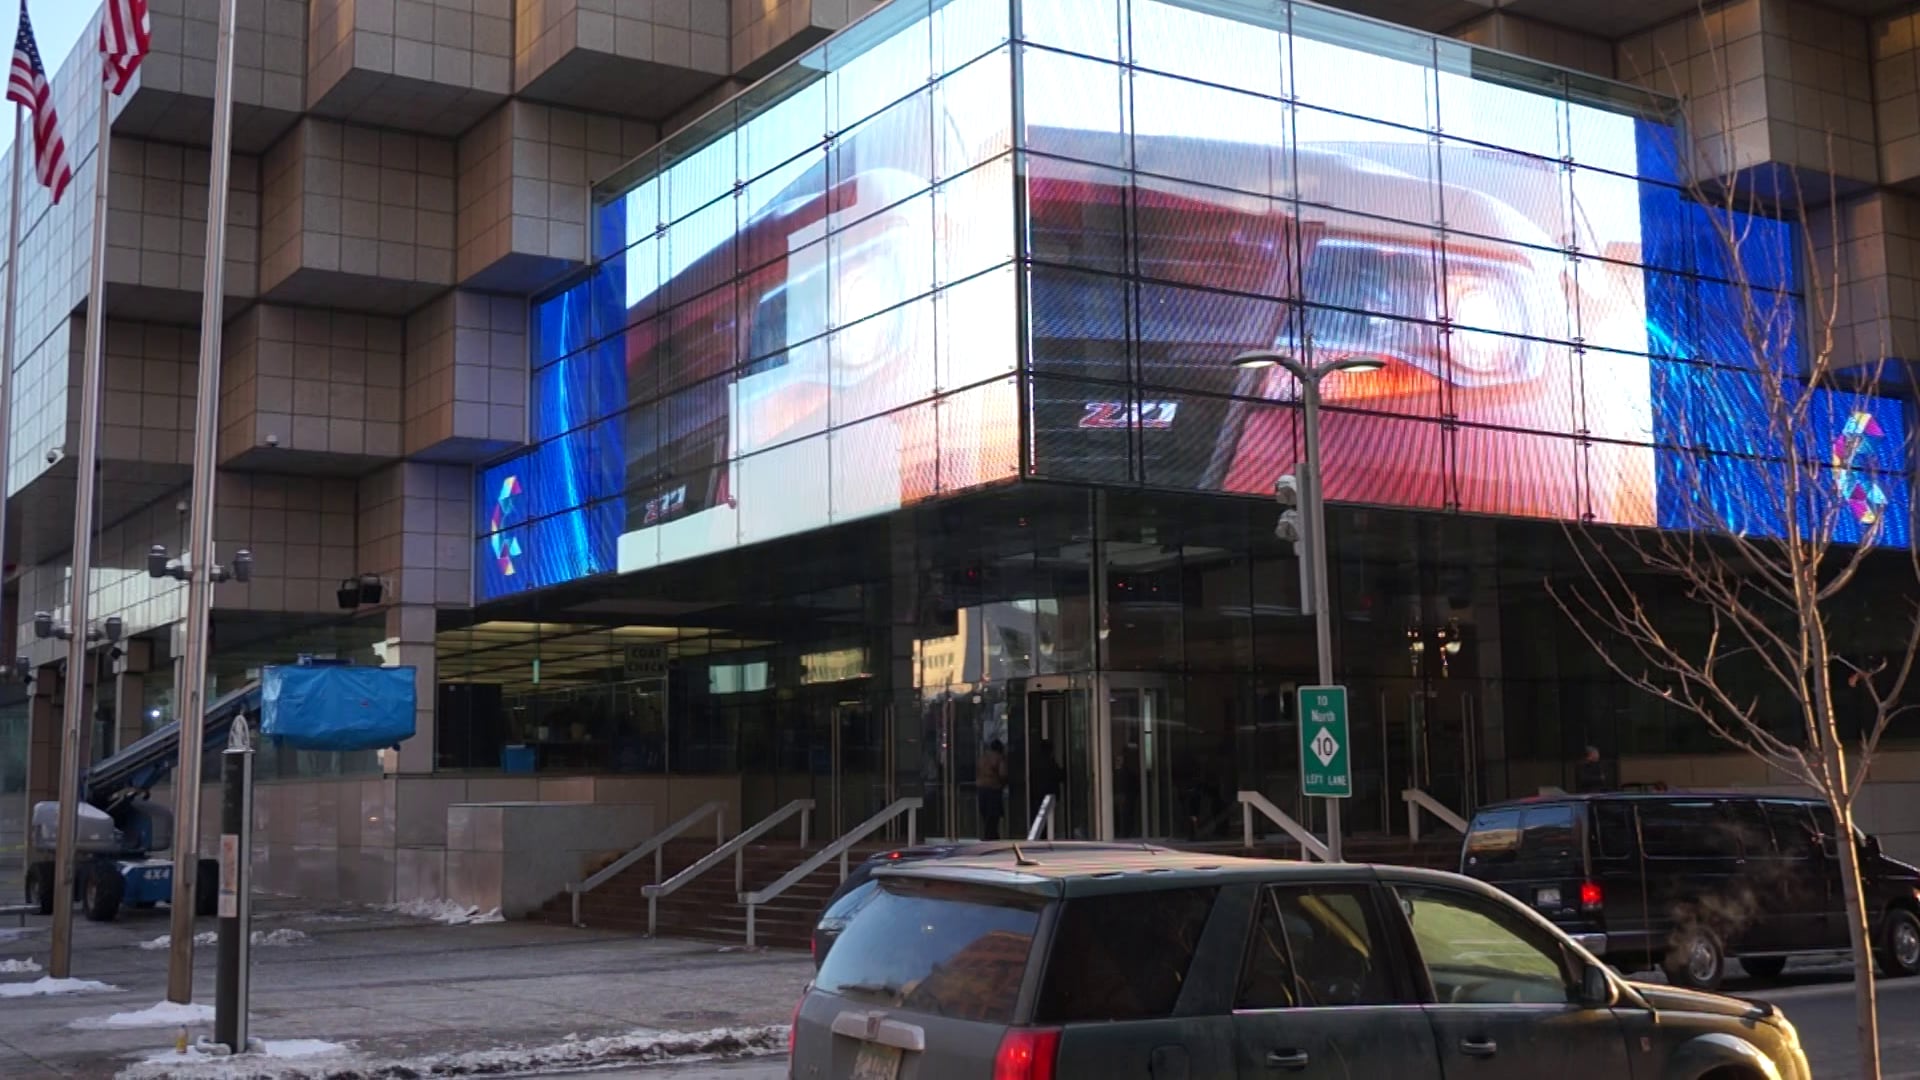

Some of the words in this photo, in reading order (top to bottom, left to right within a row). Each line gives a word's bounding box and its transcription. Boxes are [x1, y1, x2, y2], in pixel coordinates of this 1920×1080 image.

[1311, 709, 1337, 723] North
[1316, 737, 1334, 756] 10
[1306, 774, 1323, 785] LEFT
[1327, 775, 1347, 787] LANE
